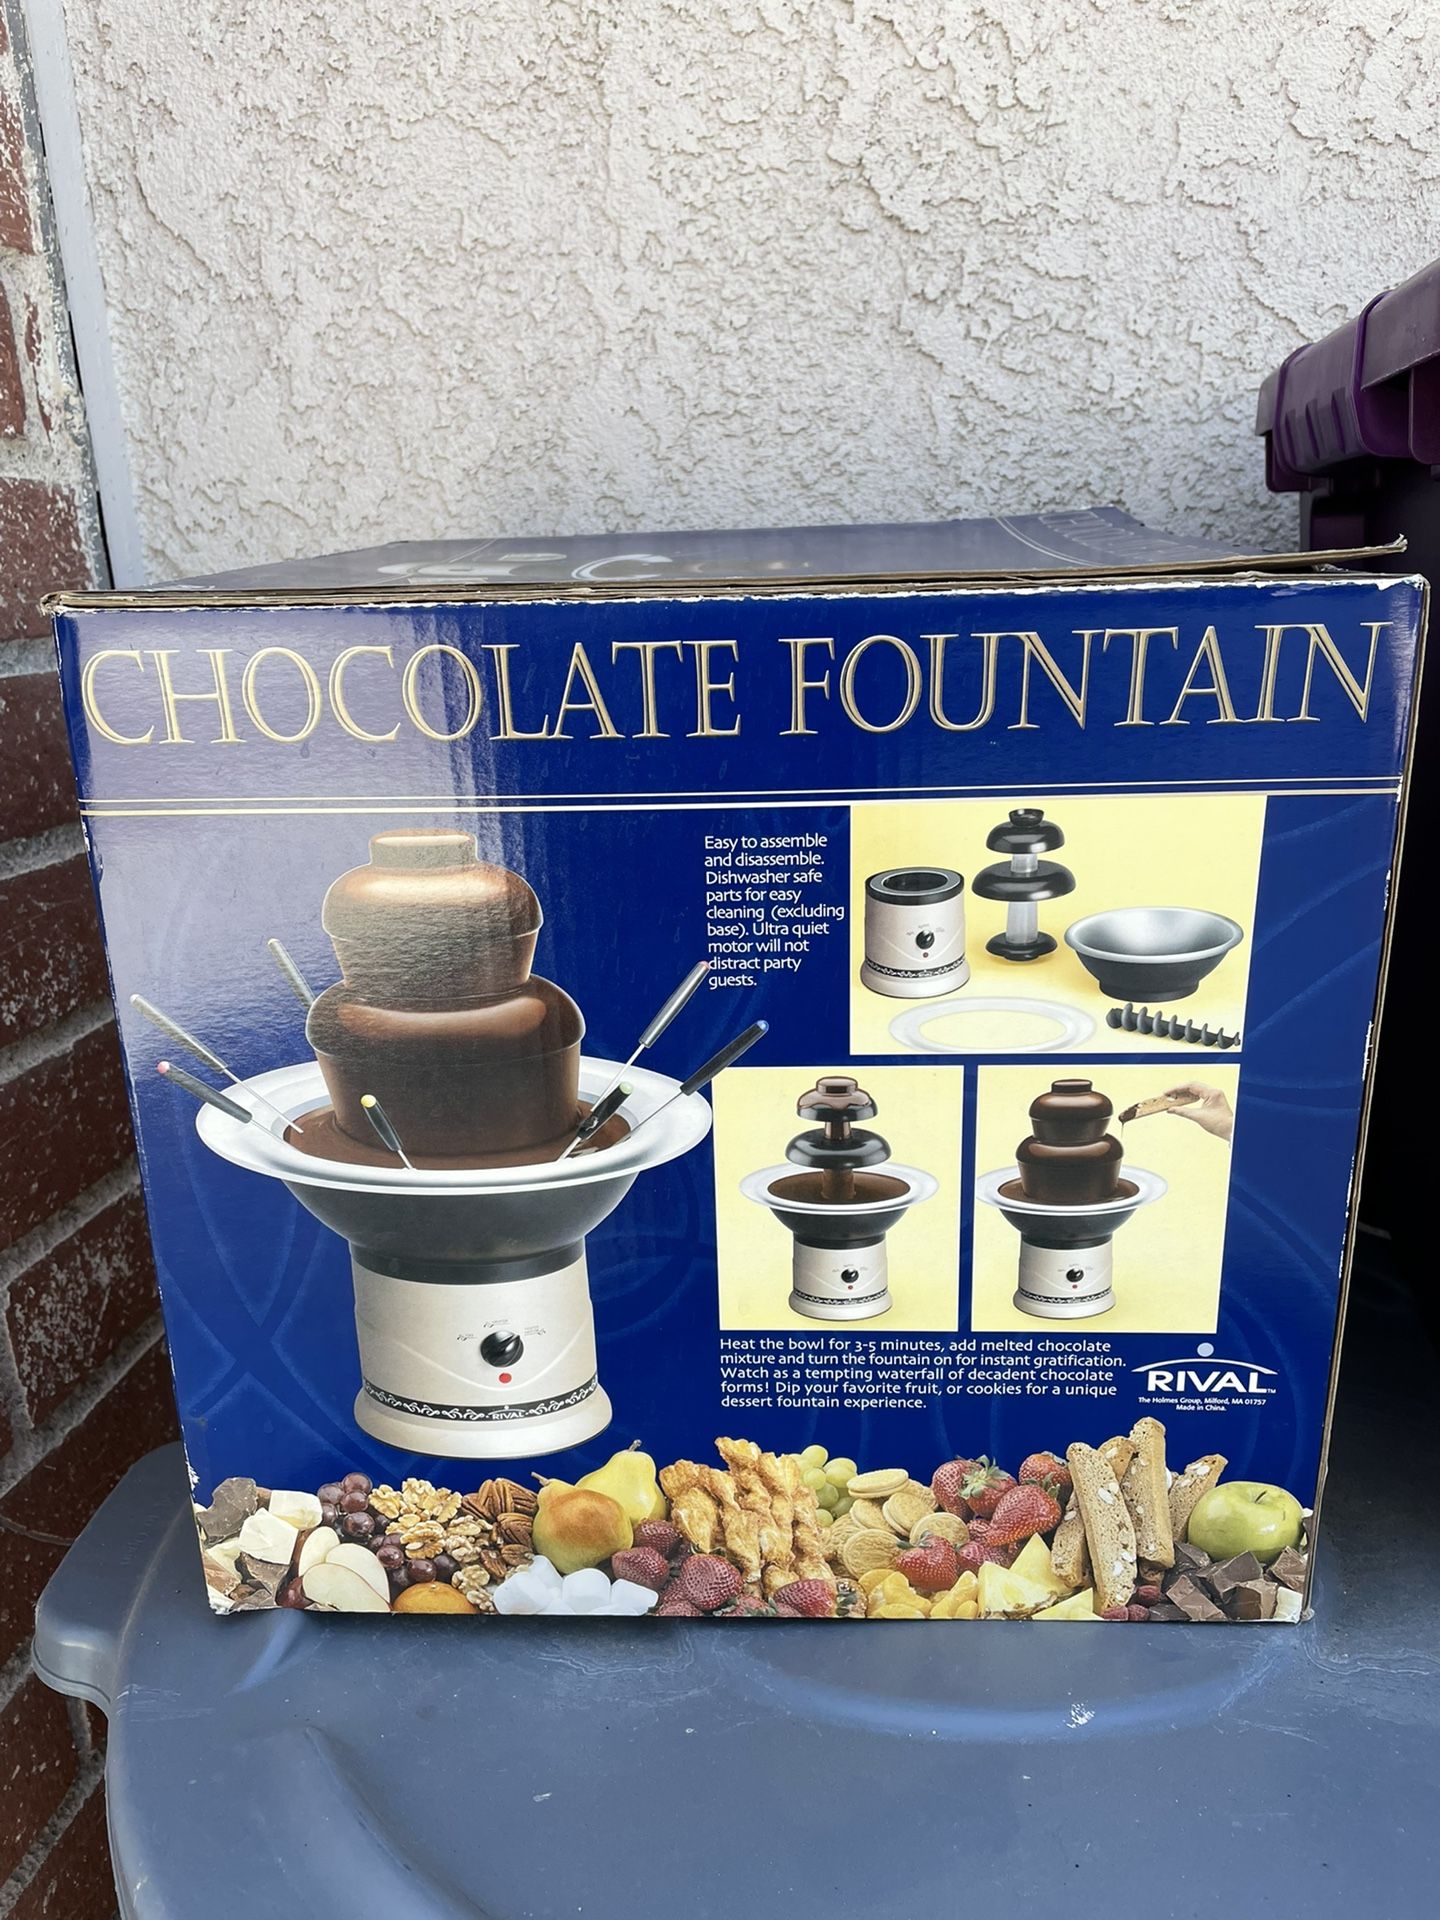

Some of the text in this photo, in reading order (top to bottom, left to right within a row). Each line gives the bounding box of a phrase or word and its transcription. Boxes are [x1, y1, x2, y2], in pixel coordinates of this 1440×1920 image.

[82, 621, 1393, 744] CHOCOLATE FOUNTAIN
[705, 833, 827, 852] Easy to assemble
[705, 851, 824, 866] and disassemble.
[706, 869, 822, 884] Dishwasher safe
[706, 888, 801, 905] parts for easy
[706, 904, 844, 921] cleaning (excluding
[707, 922, 829, 939] base). Ultra quiet
[708, 939, 810, 953] motor will not
[709, 956, 801, 972] distract party
[709, 975, 757, 990] guests.
[720, 1338, 1111, 1352] Heat the bowl for 3-5 minutes, add melted chocolate
[720, 1353, 1126, 1368] mixture and turn the fountain on for instant gratification.
[721, 1367, 1113, 1382] Watch as a tempting waterfall of decadent chocolate
[1147, 1371, 1267, 1393] RIVAL
[721, 1381, 1117, 1398] forms! Dip your favorite fruit, or cookies for a unique
[721, 1396, 926, 1410] dessert fountain experience.
[492, 1412, 525, 1420] RIVAL
